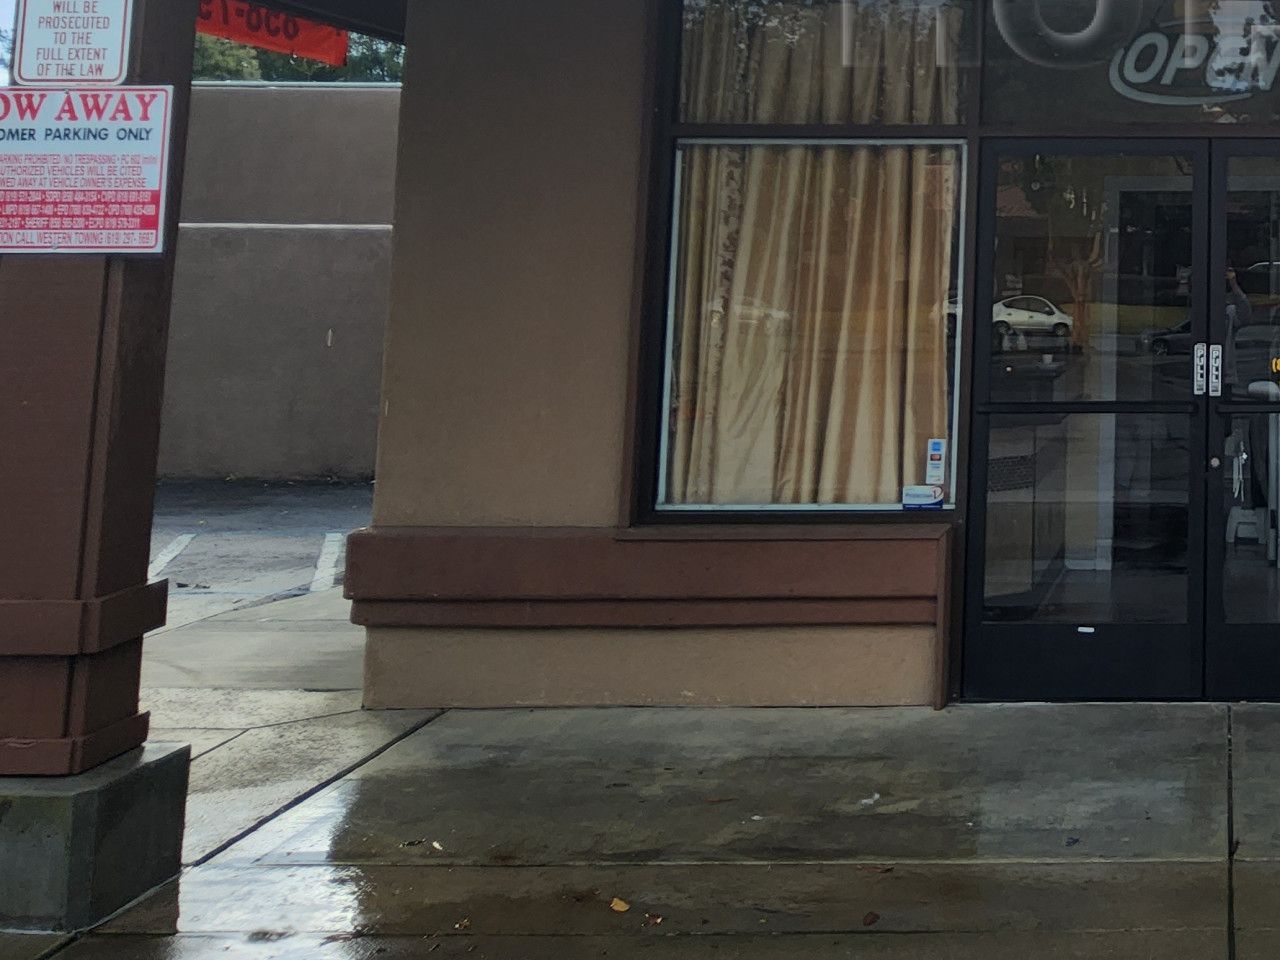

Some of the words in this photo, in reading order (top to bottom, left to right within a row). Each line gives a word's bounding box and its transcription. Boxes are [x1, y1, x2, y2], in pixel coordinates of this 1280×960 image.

[53, 1, 79, 14] WILL
[83, 1, 99, 13] BE
[38, 16, 110, 29] PROSECUTED
[53, 32, 67, 44] TO
[71, 32, 93, 44] THE
[36, 47, 63, 60] FULL
[68, 48, 108, 61] EXTENT
[36, 63, 52, 76] OF
[55, 63, 76, 76] THE
[80, 64, 104, 76] LAW
[54, 93, 158, 122] AWAY
[45, 127, 109, 141] PARKING
[116, 127, 153, 141] ONLY
[47, 166, 85, 176] VEHICLES
[87, 166, 105, 176] WILL
[107, 166, 117, 176] BE
